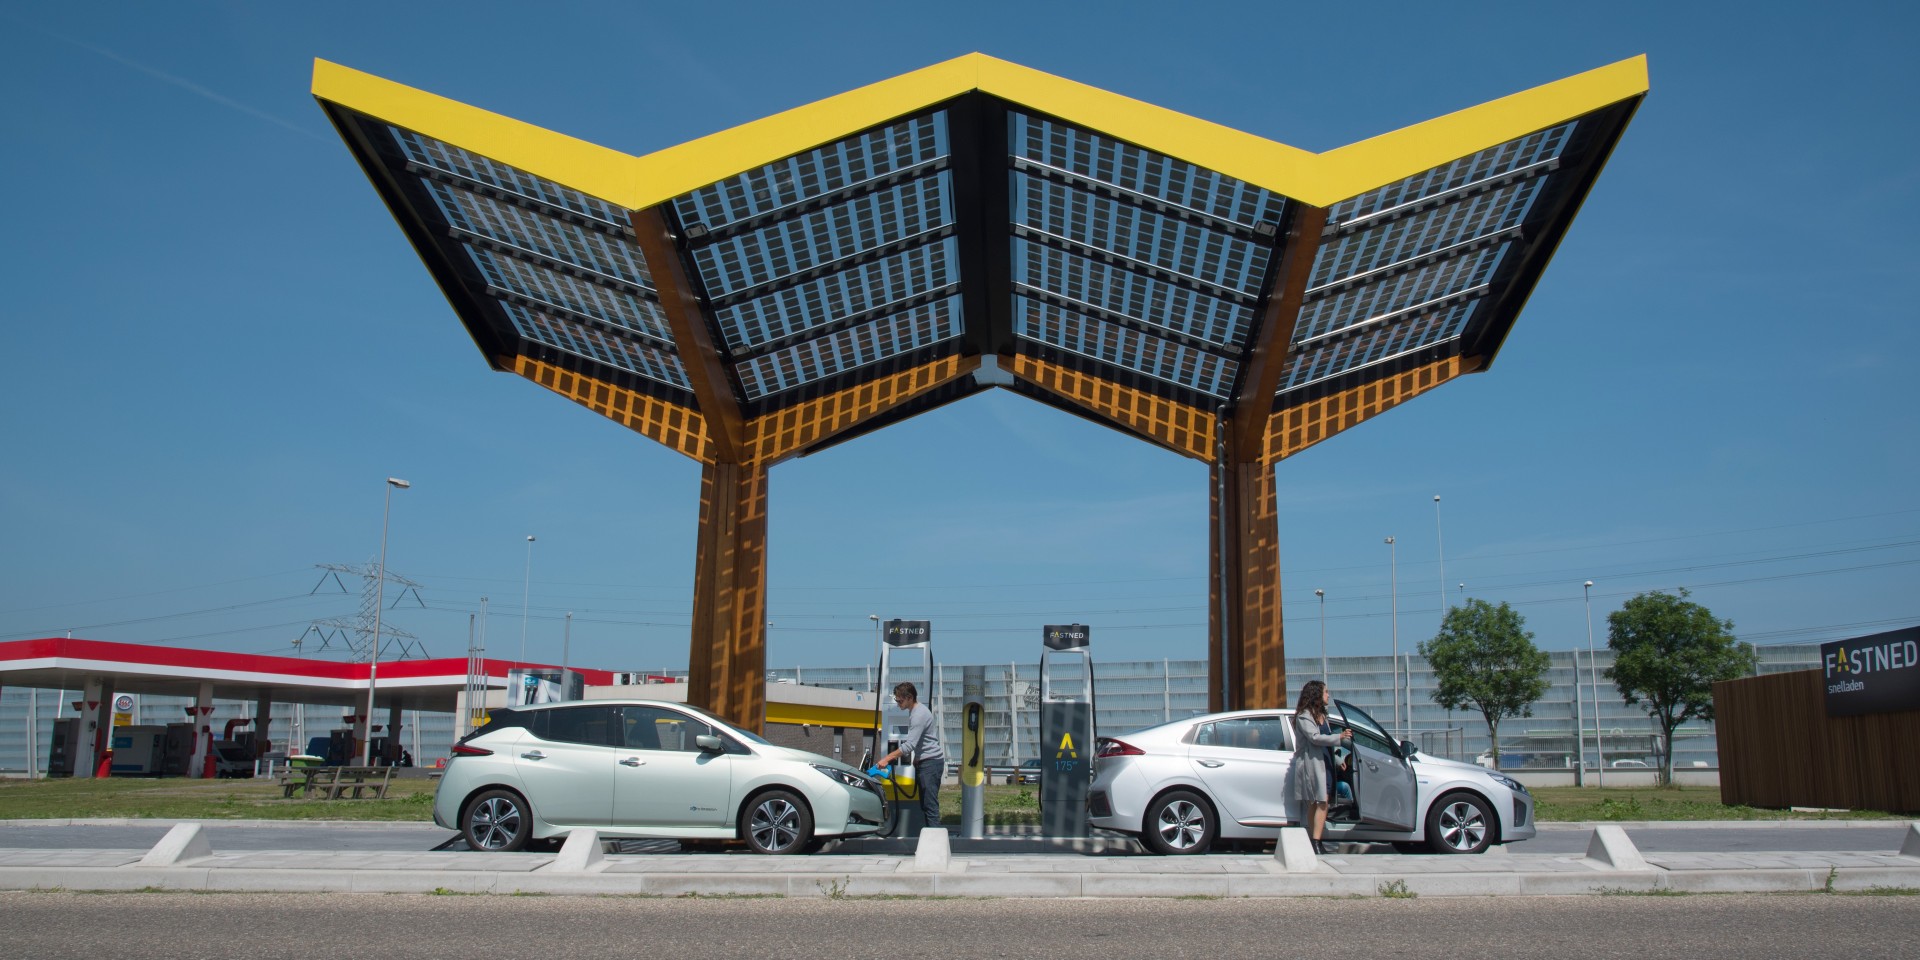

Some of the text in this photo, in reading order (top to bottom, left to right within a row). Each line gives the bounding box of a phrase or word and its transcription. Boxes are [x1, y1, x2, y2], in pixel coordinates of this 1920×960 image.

[889, 627, 925, 635] FASTNED
[1049, 631, 1084, 639] FASTNED
[1825, 640, 1918, 678] FASTNED
[1828, 680, 1864, 693] snelladen
